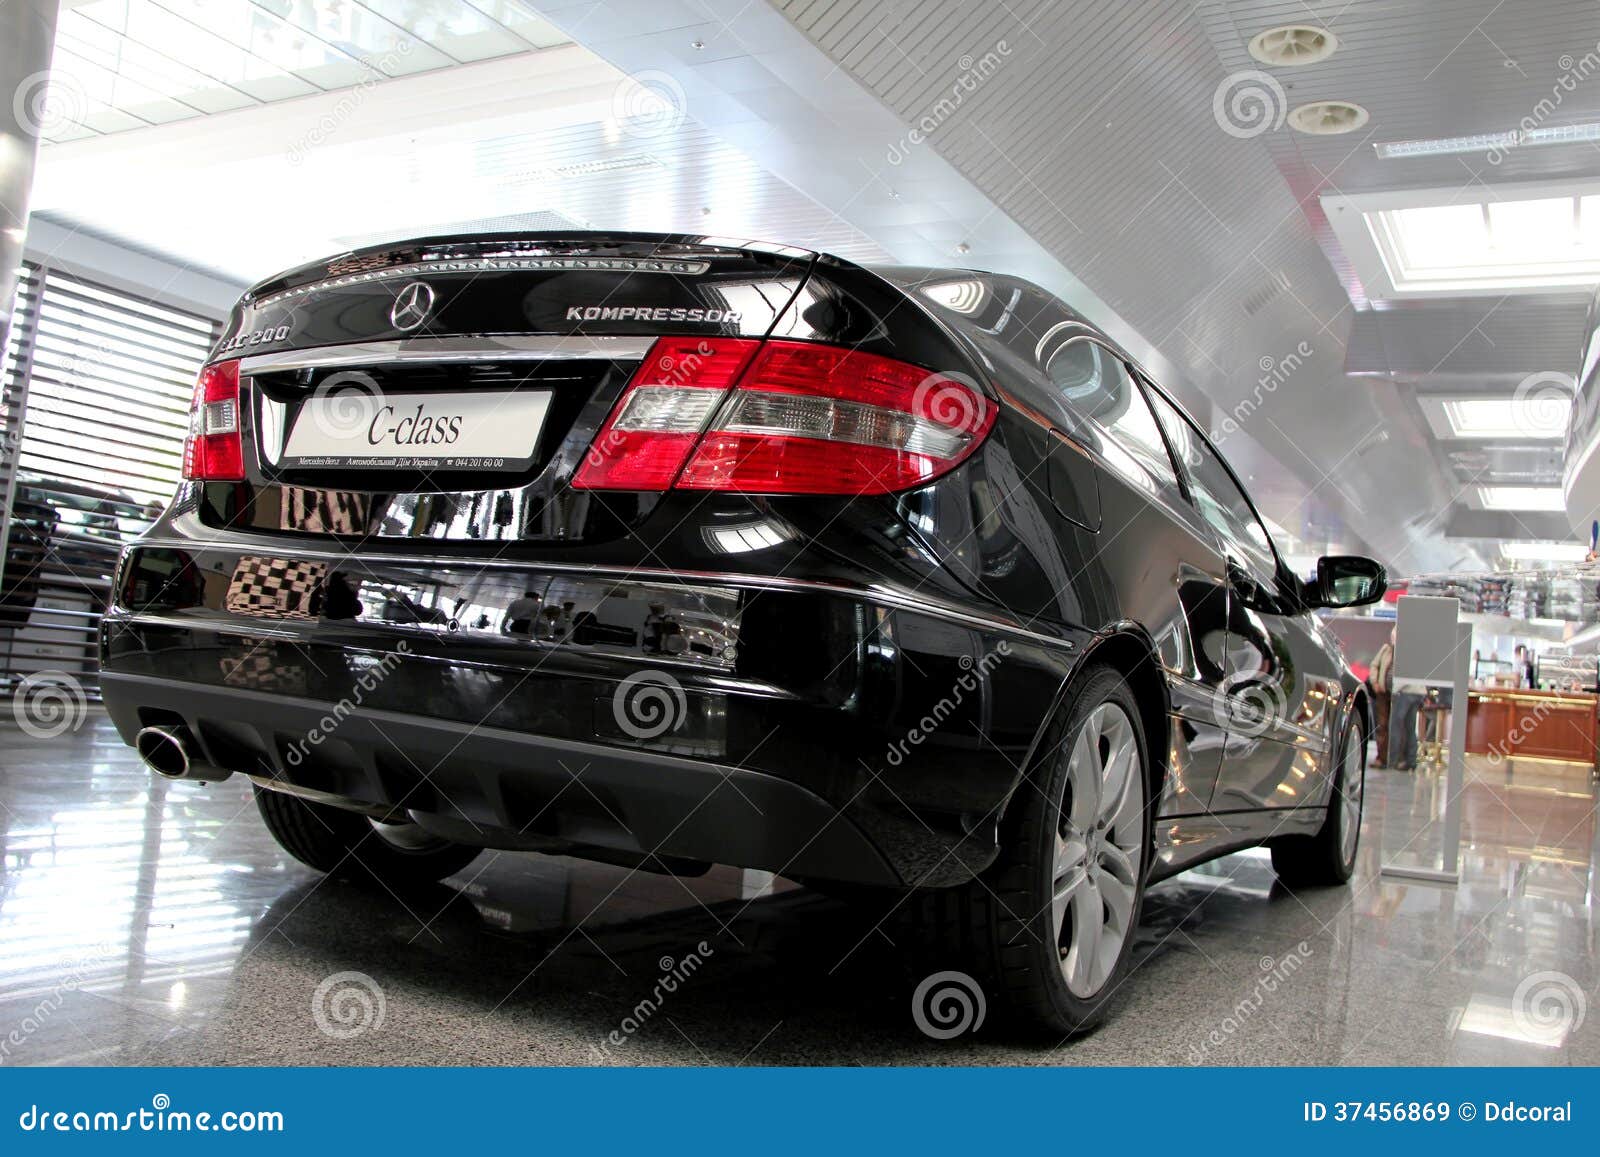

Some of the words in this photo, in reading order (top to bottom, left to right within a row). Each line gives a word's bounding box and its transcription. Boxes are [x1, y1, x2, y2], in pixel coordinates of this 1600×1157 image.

[566, 306, 742, 324] KOMPRESSOR
[250, 325, 290, 346] 200
[367, 403, 463, 446] C-class
[455, 459, 468, 467] 044
[469, 459, 481, 467] 201
[483, 459, 493, 467] 60
[494, 459, 504, 467] 00
